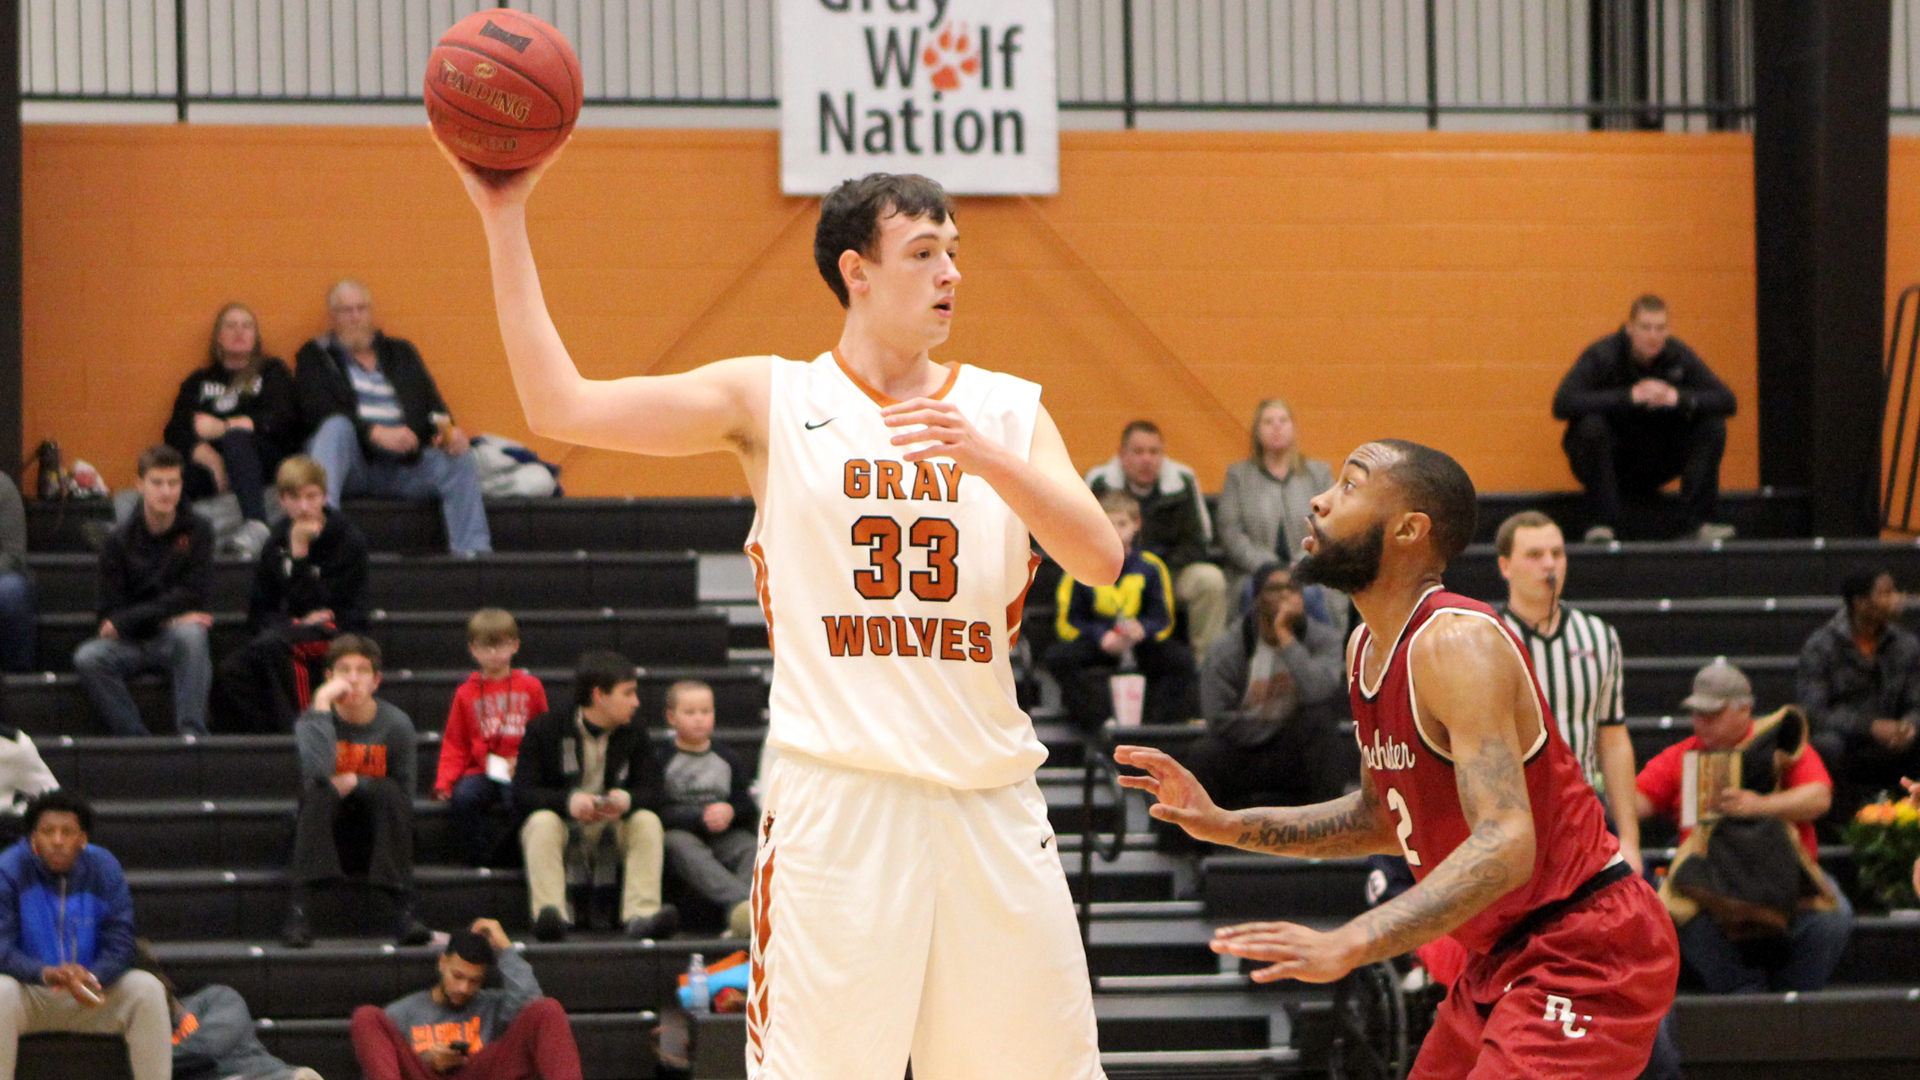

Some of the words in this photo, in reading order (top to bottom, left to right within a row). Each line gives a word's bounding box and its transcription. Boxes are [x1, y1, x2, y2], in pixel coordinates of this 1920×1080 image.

[863, 25, 1022, 90] Wlf
[819, 90, 1025, 155] Nation
[843, 458, 964, 503] GRAY
[851, 514, 960, 603] 33
[821, 614, 994, 664] WOLVES
[1353, 720, 1416, 771] ochter
[1386, 787, 1422, 867] 2
